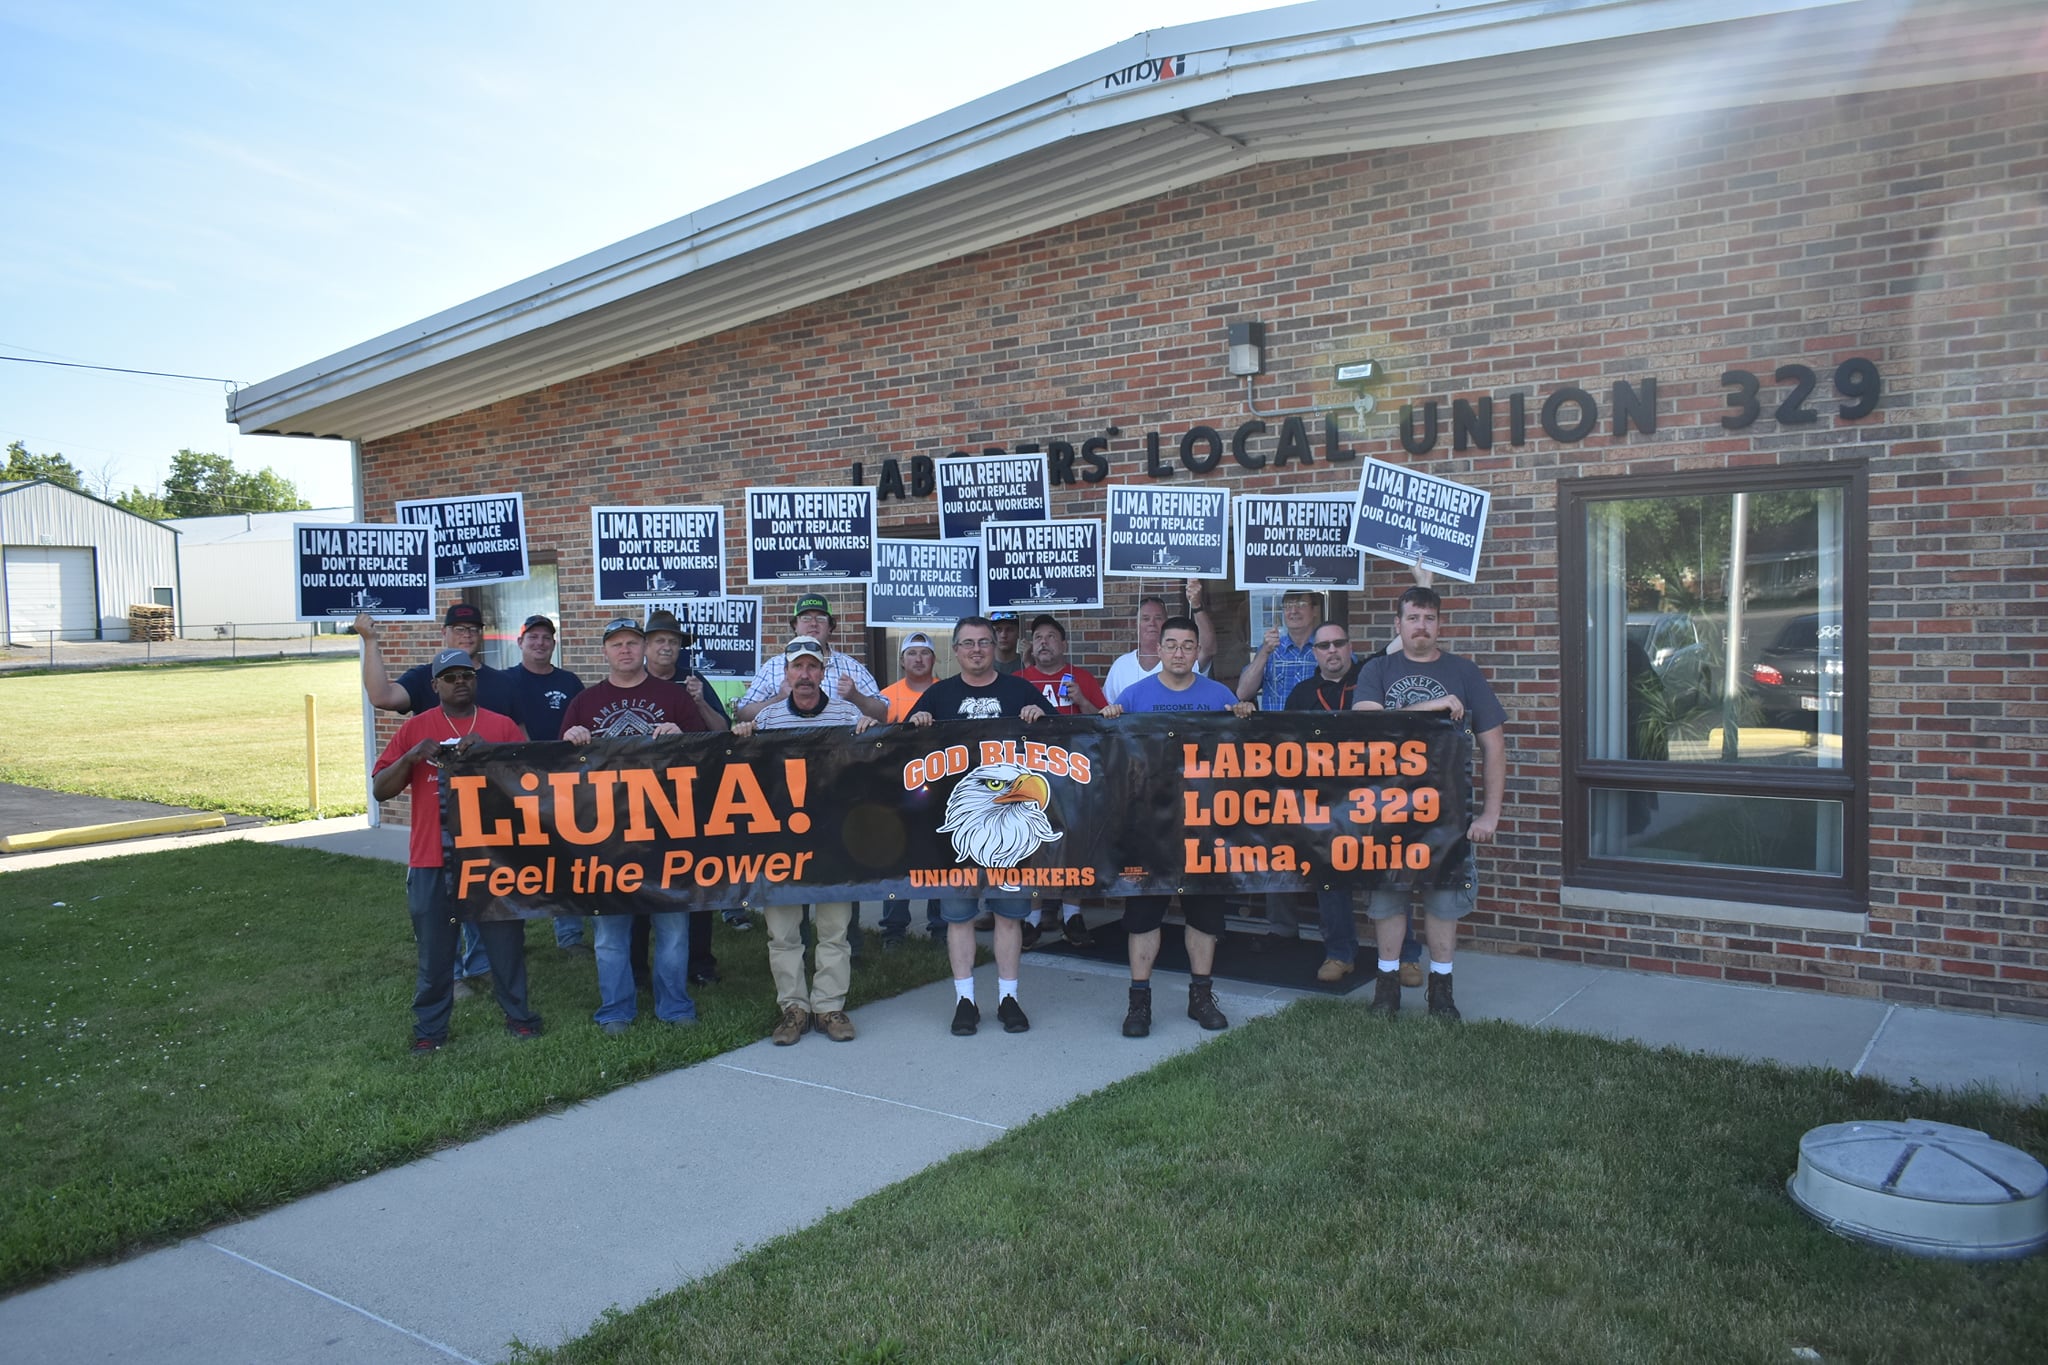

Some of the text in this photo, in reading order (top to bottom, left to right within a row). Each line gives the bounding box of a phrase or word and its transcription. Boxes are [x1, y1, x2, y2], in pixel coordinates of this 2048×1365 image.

[1148, 412, 1356, 477] LOCAL
[1401, 378, 1657, 454] UNION
[1721, 357, 1880, 430] 329
[942, 460, 1040, 487] LIMA REFINERY
[958, 484, 1027, 499] DON'T REPLACE
[1368, 465, 1480, 518] LIMA REFINERY
[445, 500, 514, 527] REFINERY
[753, 494, 867, 519] LIMA REFINERY
[945, 497, 1043, 514] OUR LOCAL WORKERS!
[1114, 491, 1221, 517] LIMA REFINERY
[1248, 502, 1283, 526] LIMA
[1382, 495, 1460, 528] DON'T REPLACE
[434, 525, 501, 542] ON'T REPLACE
[600, 513, 716, 539] LIMA REFINERY
[772, 520, 852, 534] DON'T REPLACE
[1130, 517, 1204, 531] DON'T REPLACE
[1362, 505, 1475, 548] OUR LOCAL WORKERS!
[302, 530, 425, 555] LIMA REFINERY
[754, 536, 869, 551] OUR LOCAL WORKERS!
[988, 526, 1094, 551] LIMA REFINERY
[1113, 531, 1220, 547] OUR LOCAL WORKERS!
[1264, 528, 1341, 541] DON'T REPLACE
[466, 538, 519, 555] WORKERS!
[619, 540, 700, 554] DON'T REPLACE
[1247, 543, 1357, 557] OUR LOCAL WORKERS!
[322, 557, 408, 570] DON'T REPLACE
[601, 556, 718, 571] OUR LOCAL WORKERS!
[911, 546, 976, 569] REFINERY
[1005, 551, 1078, 565] DON'T REPLACE
[303, 574, 326, 587] OUR
[330, 574, 365, 587] LOCAL
[368, 574, 427, 587] WORKERS!
[890, 569, 962, 583] DON'T REPLACE
[989, 565, 1095, 580] OUR LOCAL WORKERS!
[874, 584, 977, 597] OUR LOCAL WORKERS!
[691, 602, 754, 623] REFINERY
[697, 624, 739, 636] REPLACE
[705, 639, 754, 651] WORKERS!
[1389, 677, 1432, 699] MONKEY
[593, 699, 665, 724] AMERICAN
[1152, 704, 1194, 712] BECOME
[904, 740, 1092, 791] GOD BLESS
[1183, 741, 1427, 778] LABORERS
[450, 759, 811, 848] LiUNA!
[1184, 788, 1440, 826] LOCAL 329
[1184, 838, 1311, 876] Lima,
[1331, 835, 1431, 871] Ohio
[458, 850, 813, 899] Feel the Power
[909, 868, 978, 887] UNION
[986, 867, 1096, 887] WORKERS
